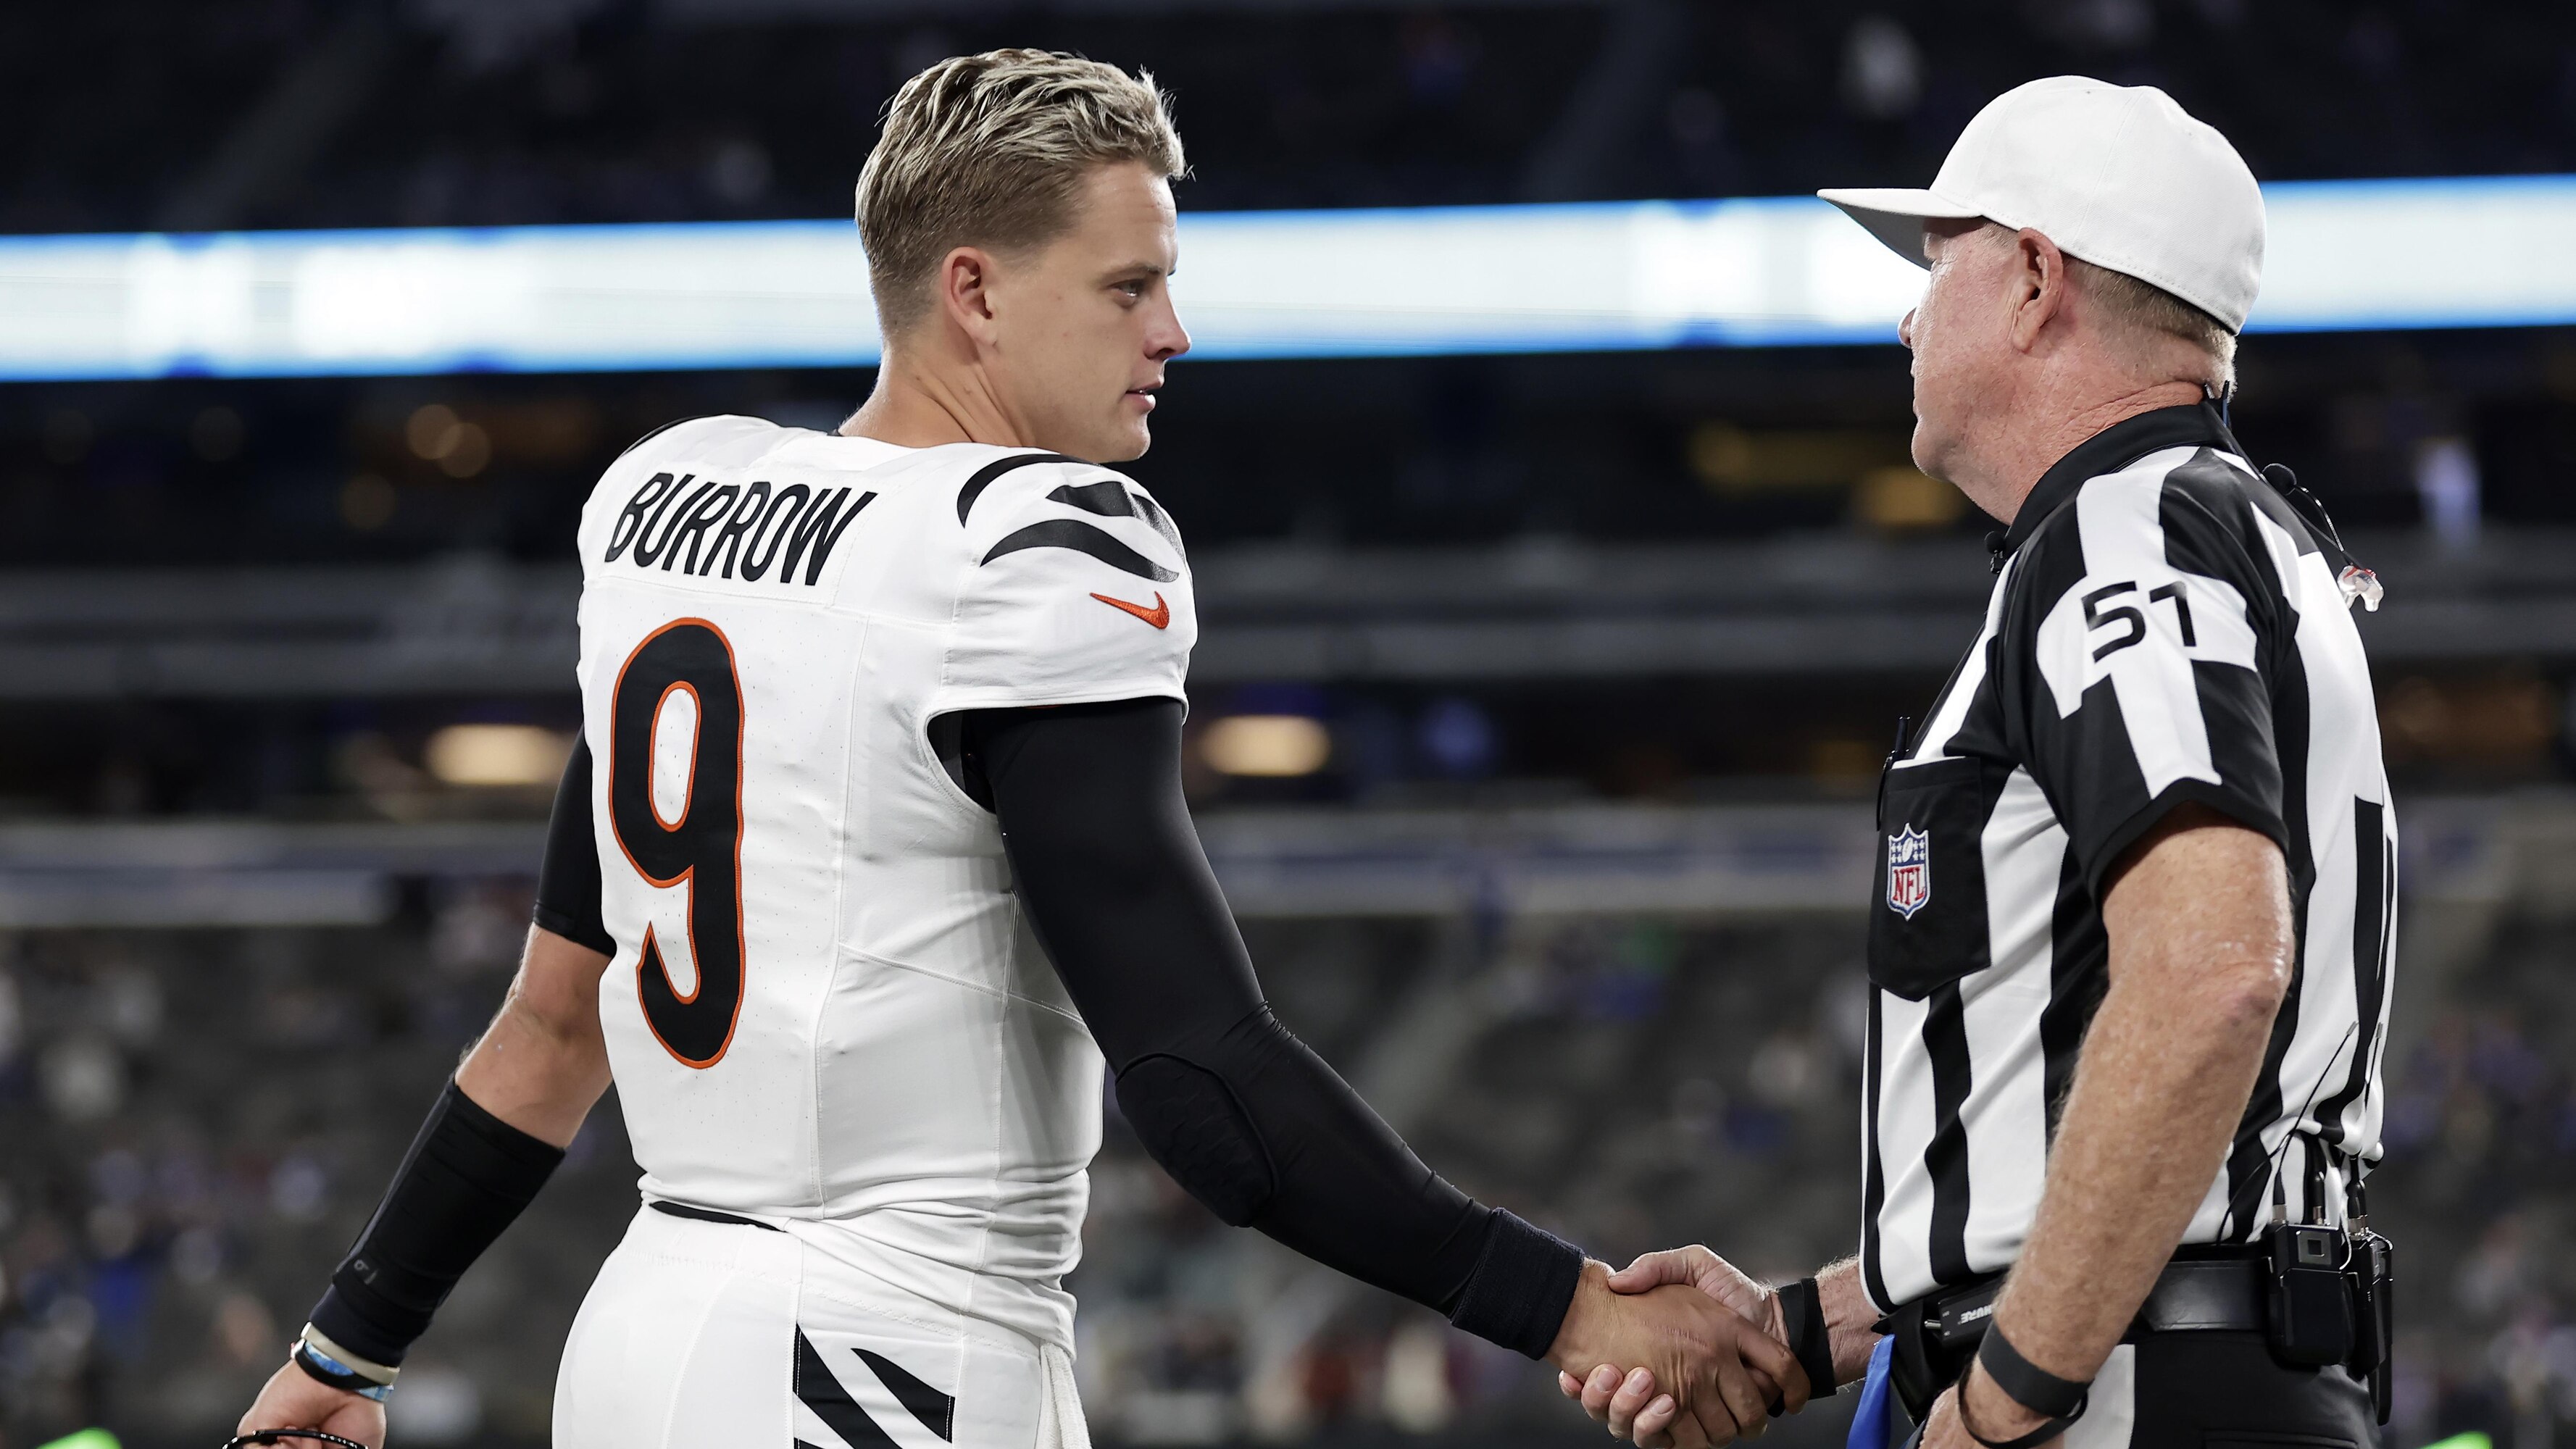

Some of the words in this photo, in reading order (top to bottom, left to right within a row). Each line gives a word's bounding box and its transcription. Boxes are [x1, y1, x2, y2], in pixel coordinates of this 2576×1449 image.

[604, 472, 878, 586] BURROW
[2081, 580, 2196, 664] 51
[608, 617, 746, 1069] 9
[1892, 867, 1925, 906] NFL
[1960, 1304, 1993, 1324] HURE
